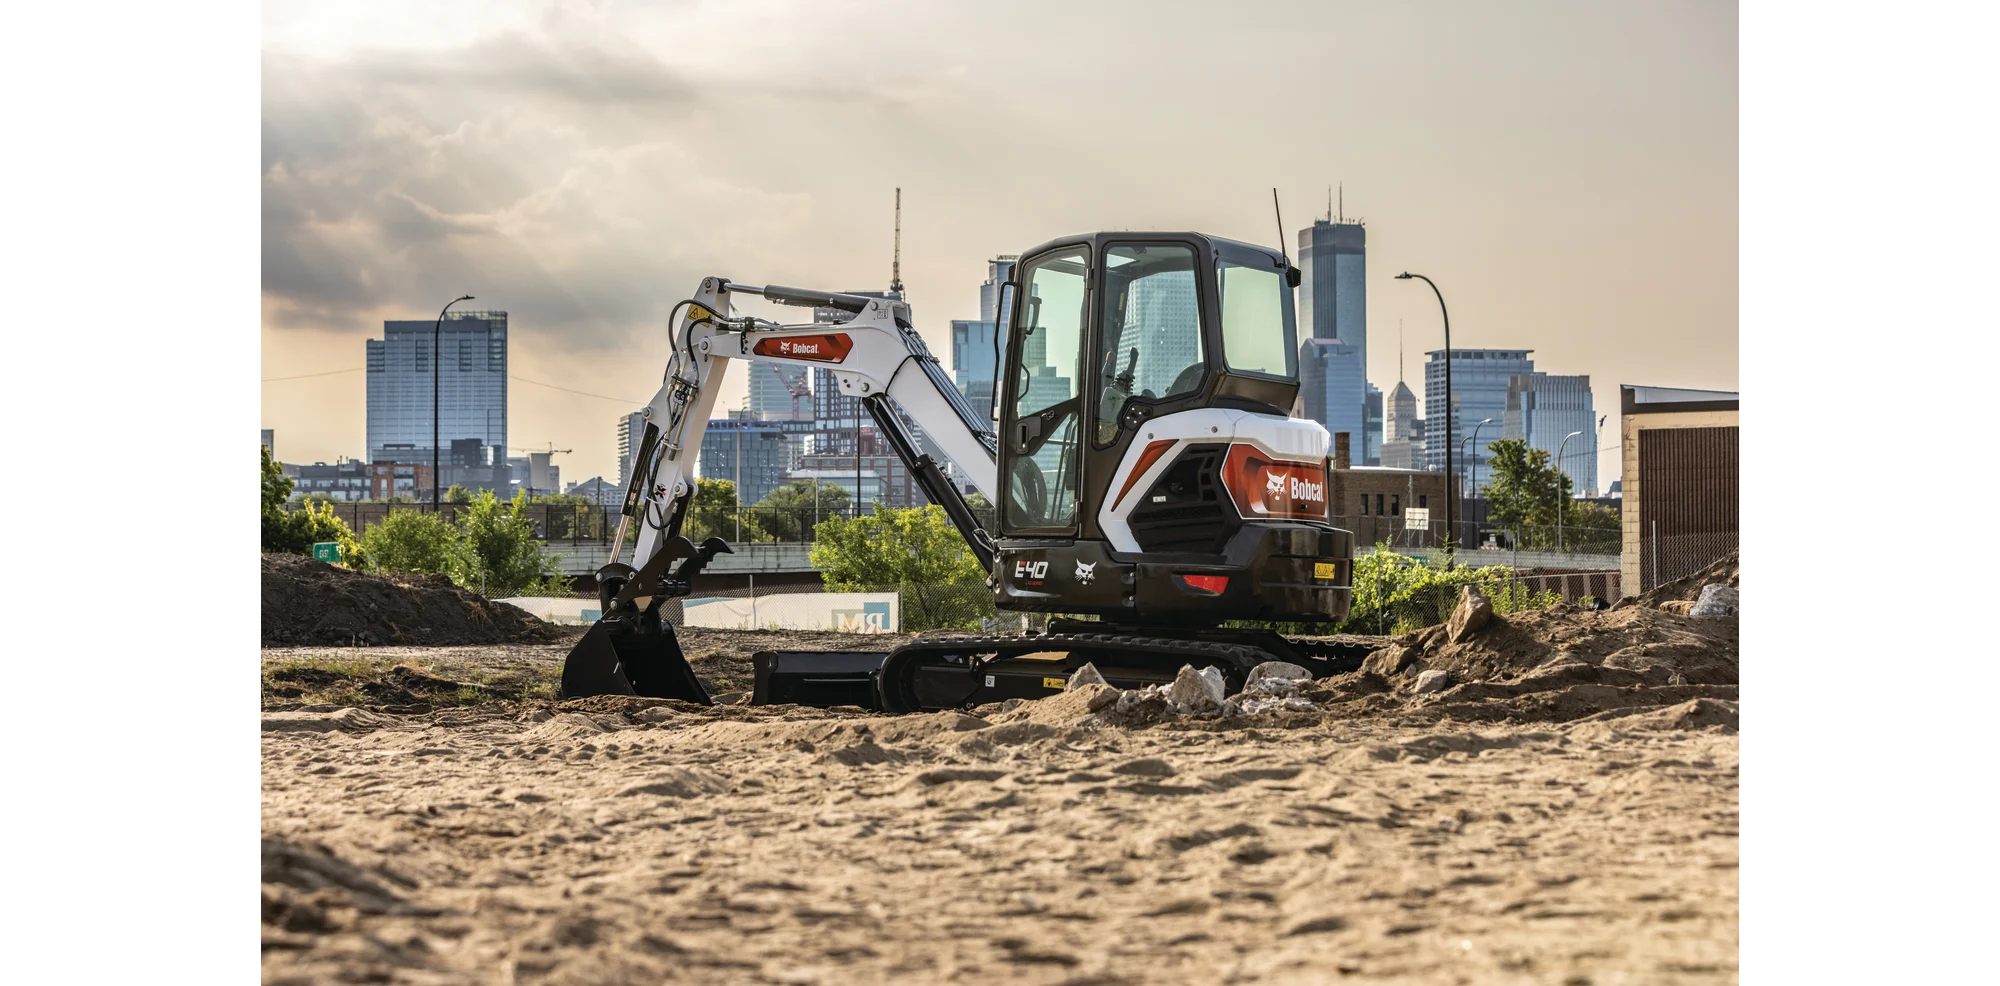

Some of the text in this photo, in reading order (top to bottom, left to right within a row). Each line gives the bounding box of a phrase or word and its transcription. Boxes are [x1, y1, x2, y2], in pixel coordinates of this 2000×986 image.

[792, 343, 819, 354] Bobcat
[1291, 477, 1324, 502] Bobcat
[1014, 560, 1049, 579] E40
